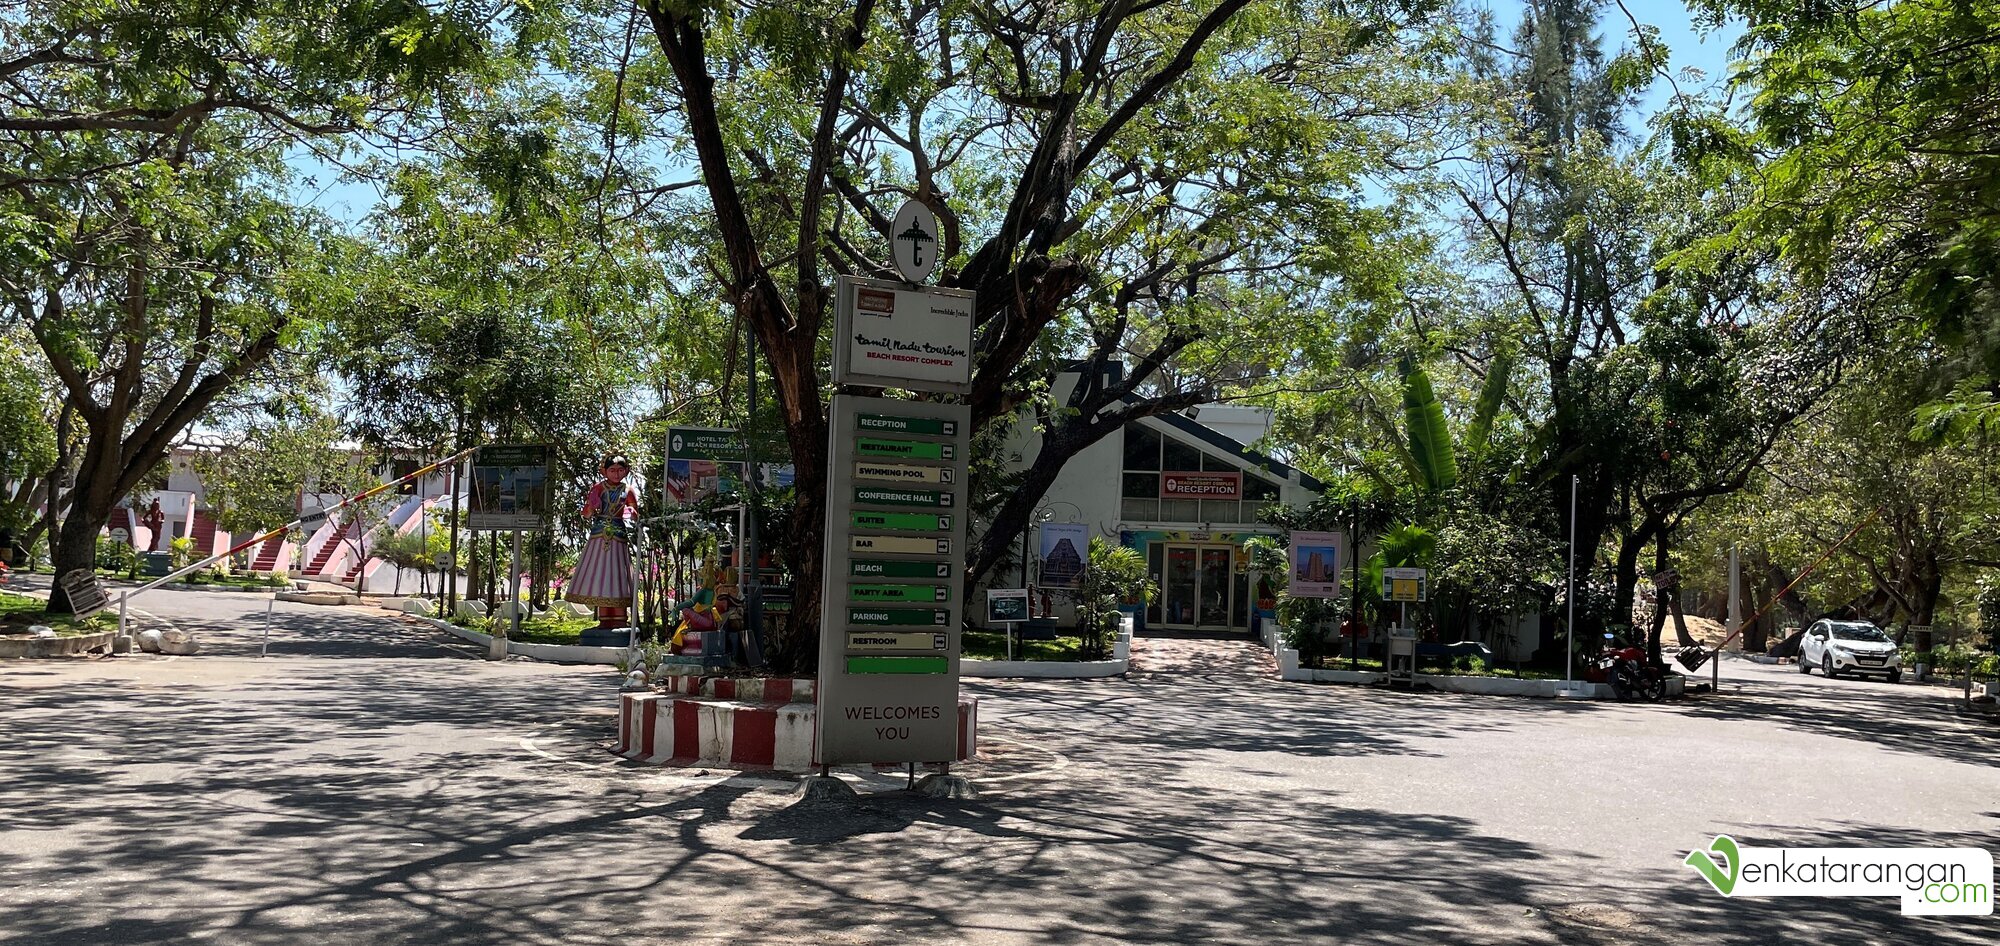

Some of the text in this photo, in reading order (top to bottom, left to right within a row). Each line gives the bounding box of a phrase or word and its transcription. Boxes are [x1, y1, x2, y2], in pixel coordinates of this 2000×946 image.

[931, 306, 955, 316] Incredible
[922, 342, 967, 358] tourism
[866, 351, 954, 367] BEACH RESORT COMPLEX
[861, 418, 907, 429] RECEPTION
[860, 443, 913, 454] RESTAURANT
[859, 467, 925, 479] SWIMMING POOL
[1177, 486, 1235, 494] RECEPTION
[858, 491, 934, 503] CONFERENCE HALL
[857, 516, 885, 525] SUITES
[855, 540, 873, 548] BAR
[855, 564, 883, 573] BEACH
[854, 588, 905, 597] PARTY AREA
[852, 612, 889, 621] PARKING
[852, 637, 897, 646] RESTROOM
[845, 706, 940, 720] WELCOMES
[875, 727, 910, 740] YOU
